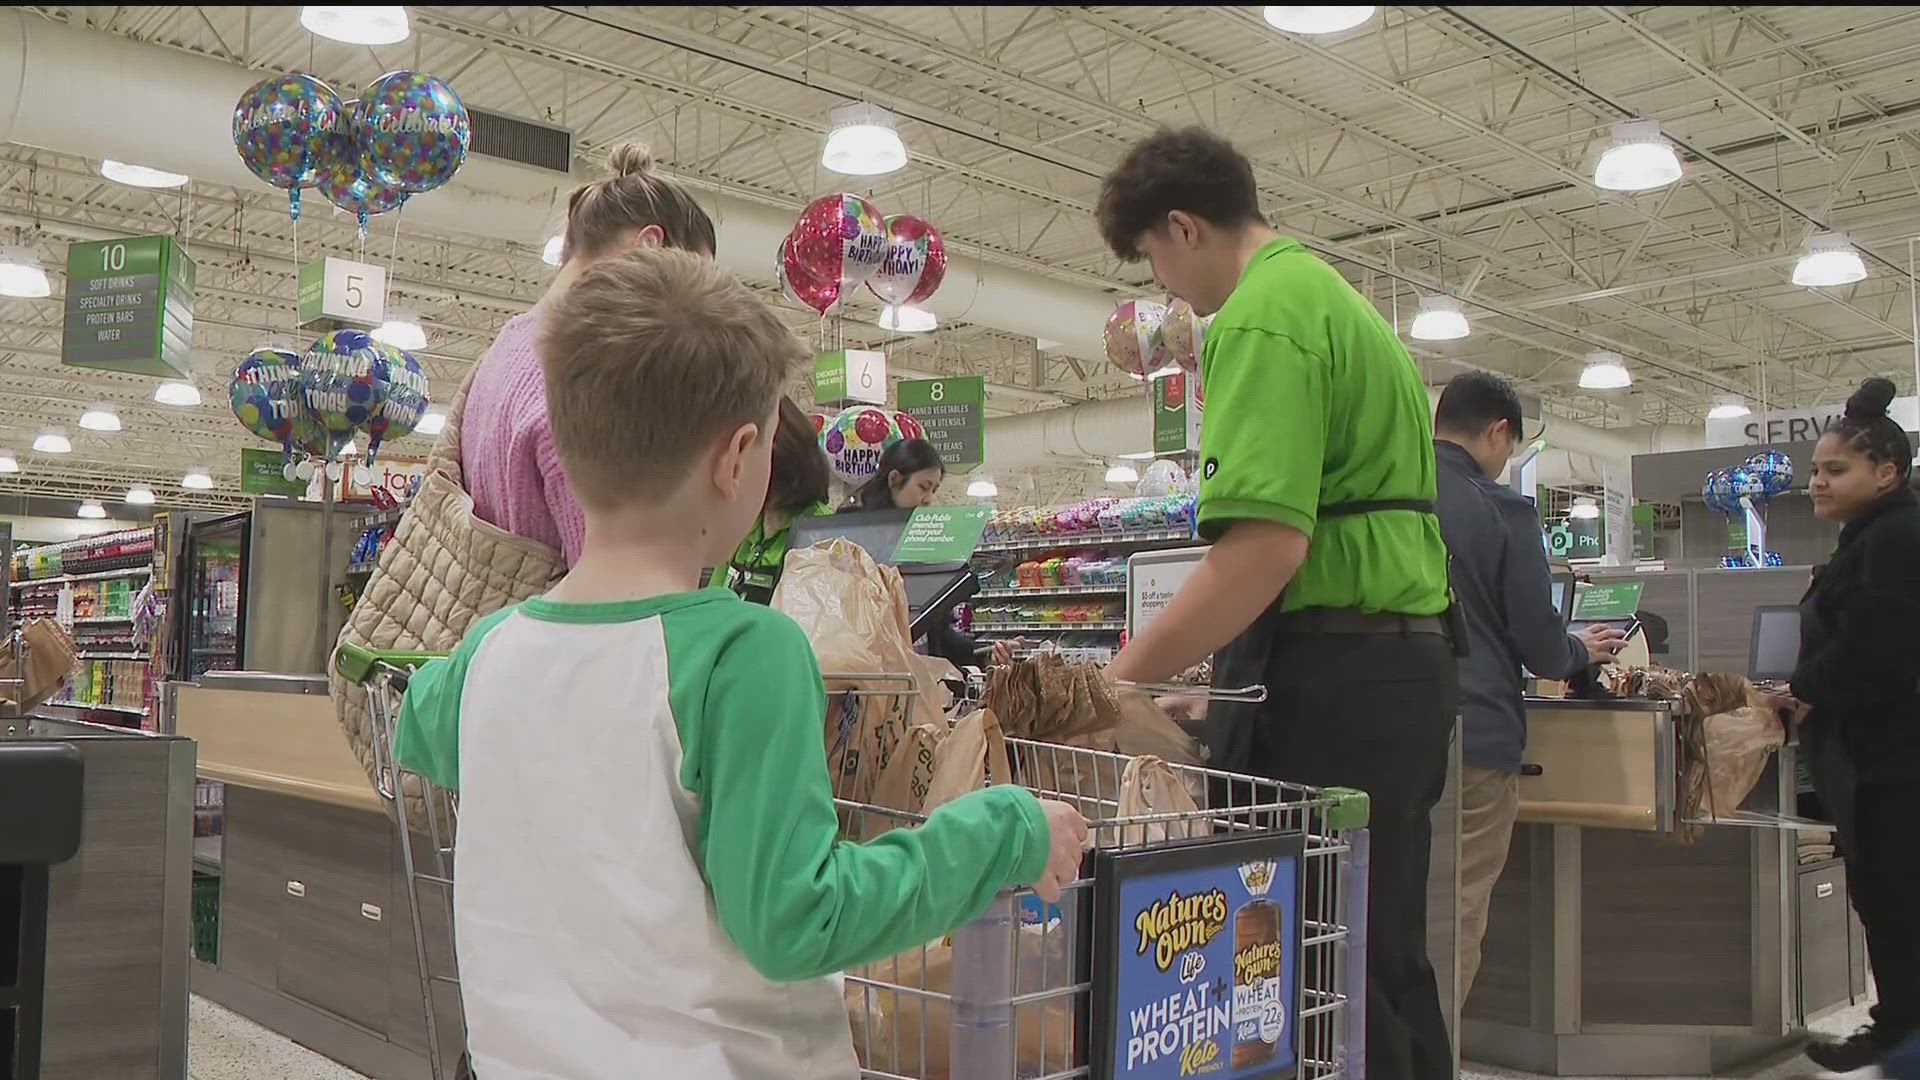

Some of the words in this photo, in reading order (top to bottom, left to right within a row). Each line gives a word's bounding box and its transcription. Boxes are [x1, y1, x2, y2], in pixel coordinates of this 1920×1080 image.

[100, 244, 126, 271] 10
[90, 278, 107, 291] SOFT
[108, 276, 135, 289] DRINKS
[345, 275, 364, 309] 5
[80, 295, 115, 309] SPECIALTY
[115, 293, 142, 306] DRINKS
[86, 312, 115, 325] PROTEIN
[116, 310, 134, 323] BARS
[97, 329, 121, 341] WATER
[861, 361, 873, 389] 6
[930, 382, 944, 401] 8
[269, 399, 300, 420] TOD
[383, 400, 417, 426] ODAY
[907, 406, 932, 416] CANNED
[933, 404, 969, 415] VEGETABLES
[937, 417, 966, 428] UTENSILS
[1744, 415, 1841, 446] SERV
[930, 431, 948, 440] PASTA
[943, 441, 964, 451] BEANS
[843, 449, 881, 462] HAPPY
[835, 459, 877, 476] BIRTHDA
[1141, 591, 1148, 600] $5
[1135, 887, 1226, 955] Nature's
[1155, 918, 1208, 972] Own
[1180, 951, 1206, 984] Life
[1234, 941, 1281, 977] Nature's
[1244, 957, 1272, 986] Own
[1236, 984, 1277, 1006] WHEAT
[1130, 981, 1210, 1036] WHEAT
[1127, 1000, 1230, 1070] PROTEIN
[1179, 1039, 1220, 1077] Keto
